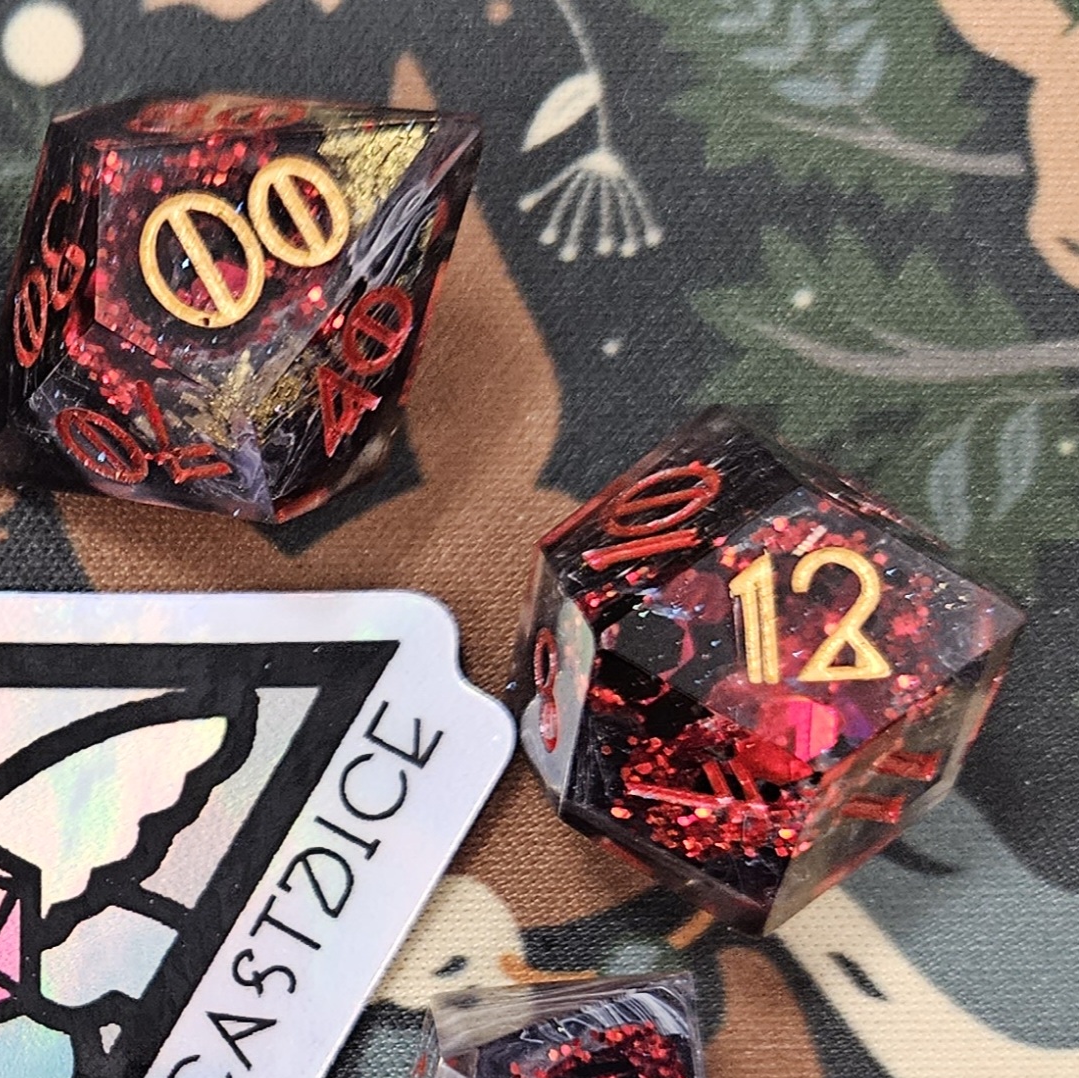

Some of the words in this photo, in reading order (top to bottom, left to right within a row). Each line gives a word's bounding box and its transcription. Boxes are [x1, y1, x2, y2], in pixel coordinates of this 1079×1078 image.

[139, 156, 351, 328] 00
[318, 286, 413, 456] 40
[582, 462, 720, 570] 10
[728, 547, 892, 684] 12
